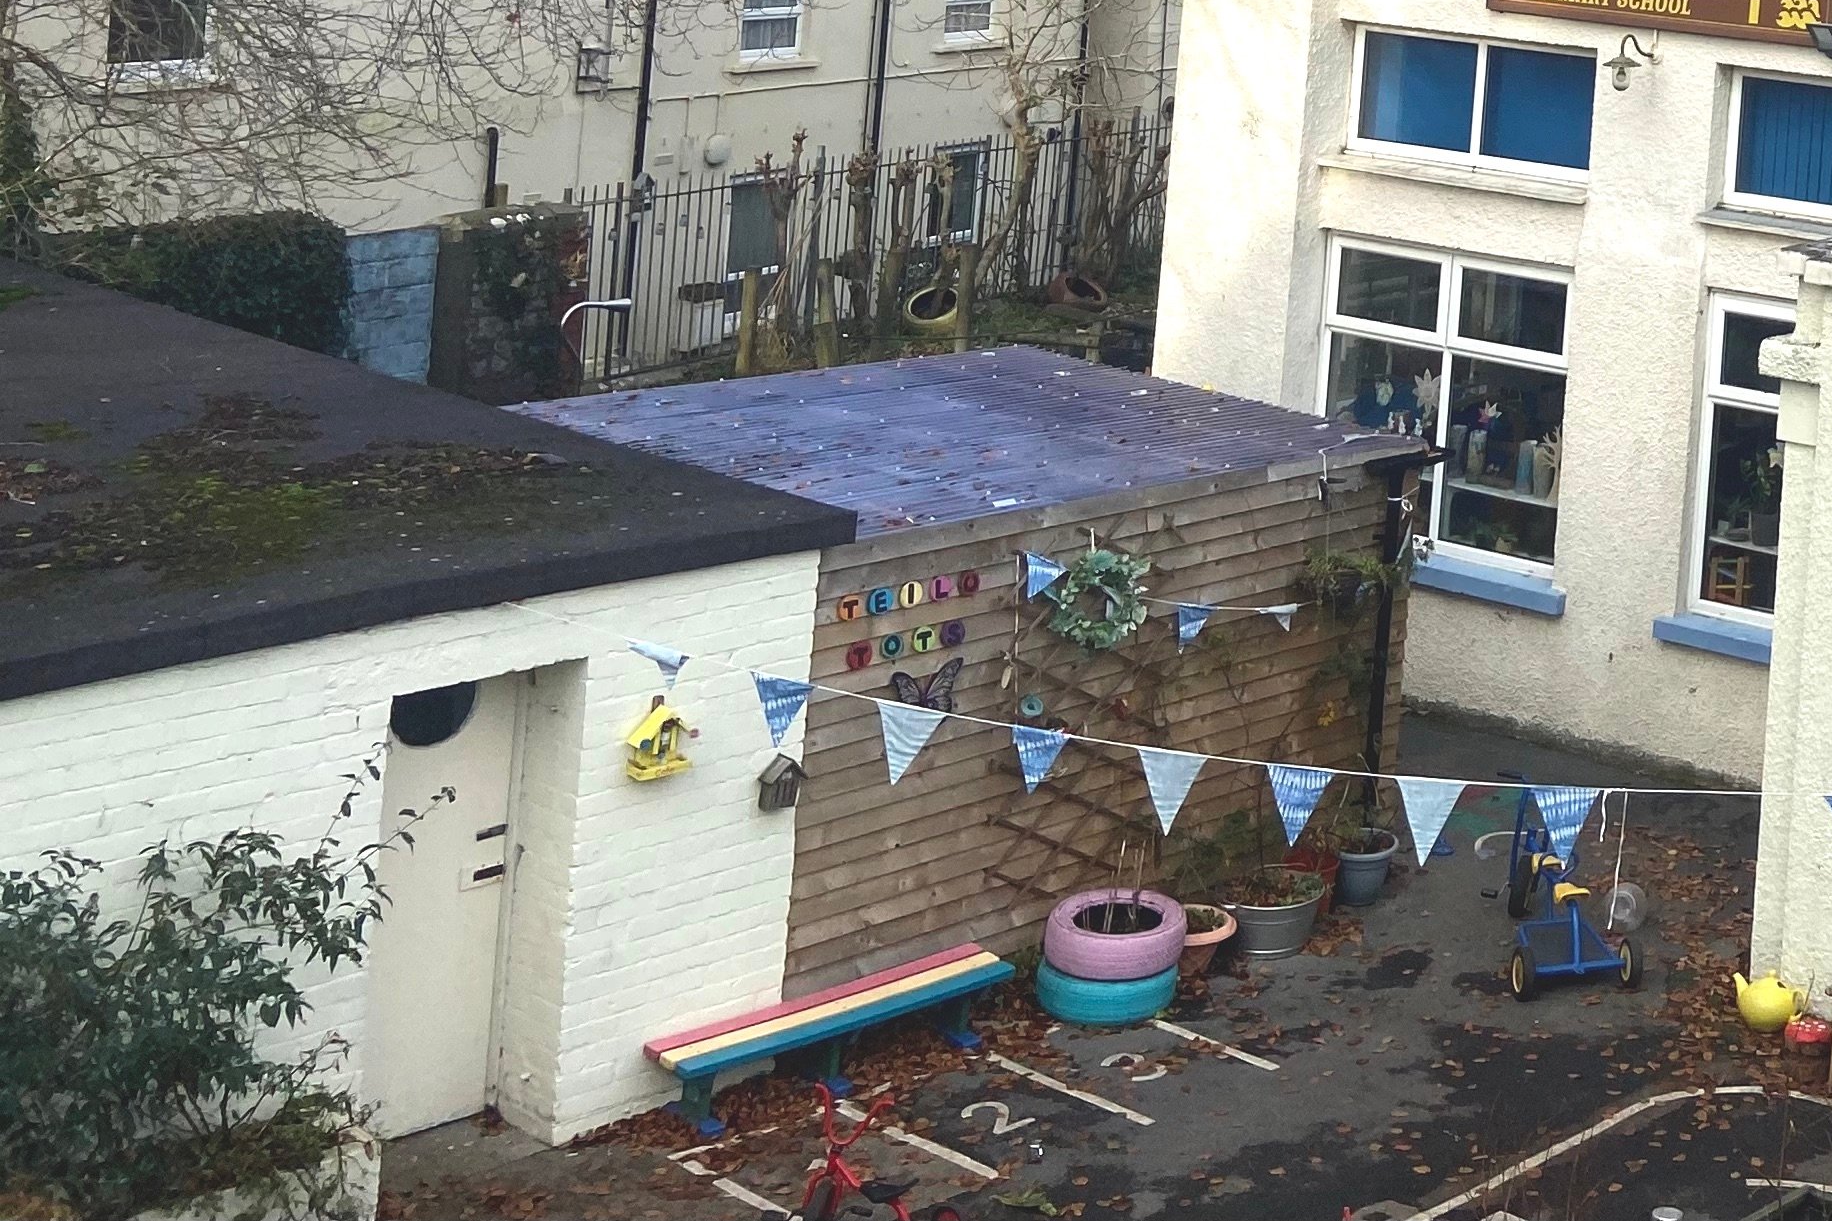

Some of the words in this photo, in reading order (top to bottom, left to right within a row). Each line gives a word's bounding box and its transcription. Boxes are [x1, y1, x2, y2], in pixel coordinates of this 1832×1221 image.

[842, 577, 977, 620] TEILO
[851, 623, 963, 665] TOTS
[961, 1101, 1036, 1135] 2
